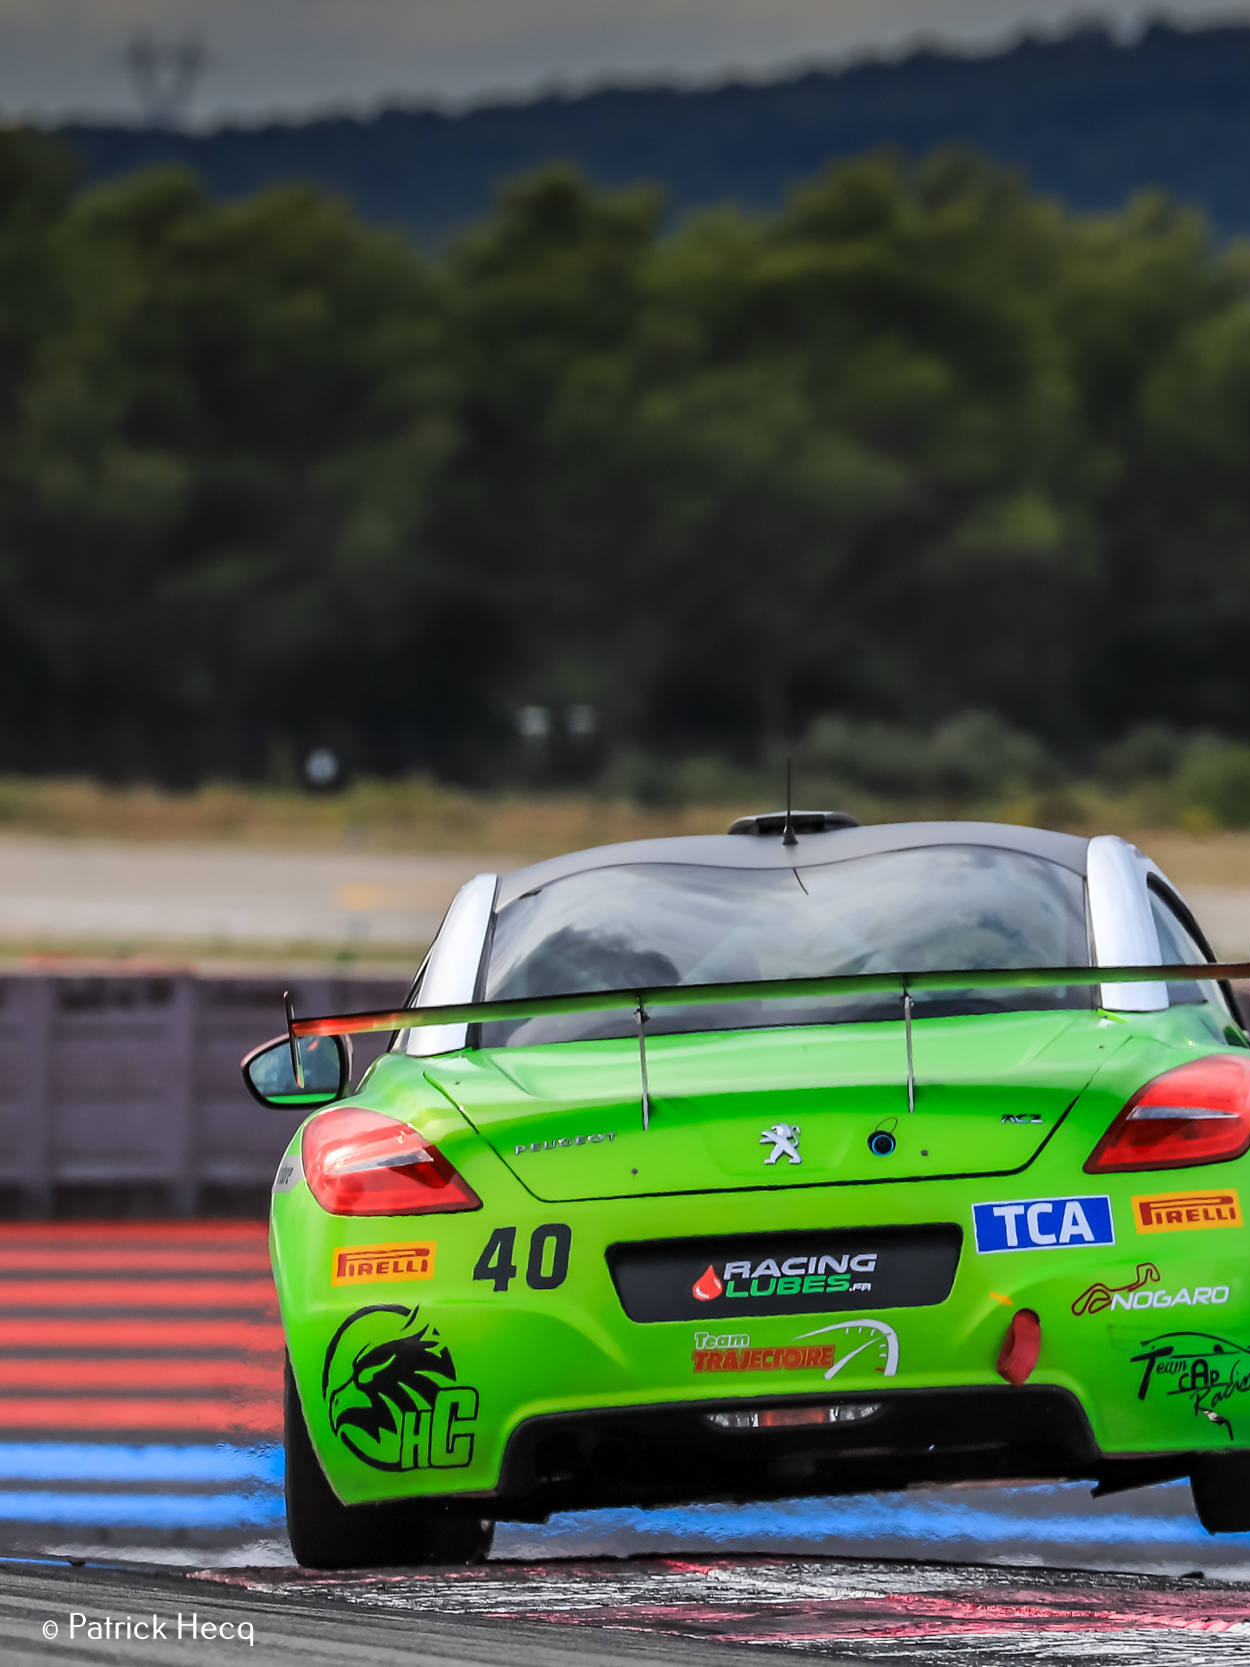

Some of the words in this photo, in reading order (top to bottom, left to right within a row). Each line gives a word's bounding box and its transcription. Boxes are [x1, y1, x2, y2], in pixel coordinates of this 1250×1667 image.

[514, 1132, 618, 1156] PEUGEOT
[993, 1200, 1095, 1247] TCA
[1139, 1195, 1236, 1226] PIRELLI
[336, 1248, 430, 1278] PIRELLI
[472, 1223, 572, 1292] 40
[723, 1253, 878, 1281] RACING
[1110, 1286, 1230, 1312] NOGARO
[694, 1332, 750, 1350] Team
[692, 1345, 836, 1373] TRAJECTOIRE
[1130, 1346, 1187, 1400] Team
[400, 1386, 479, 1470] HC
